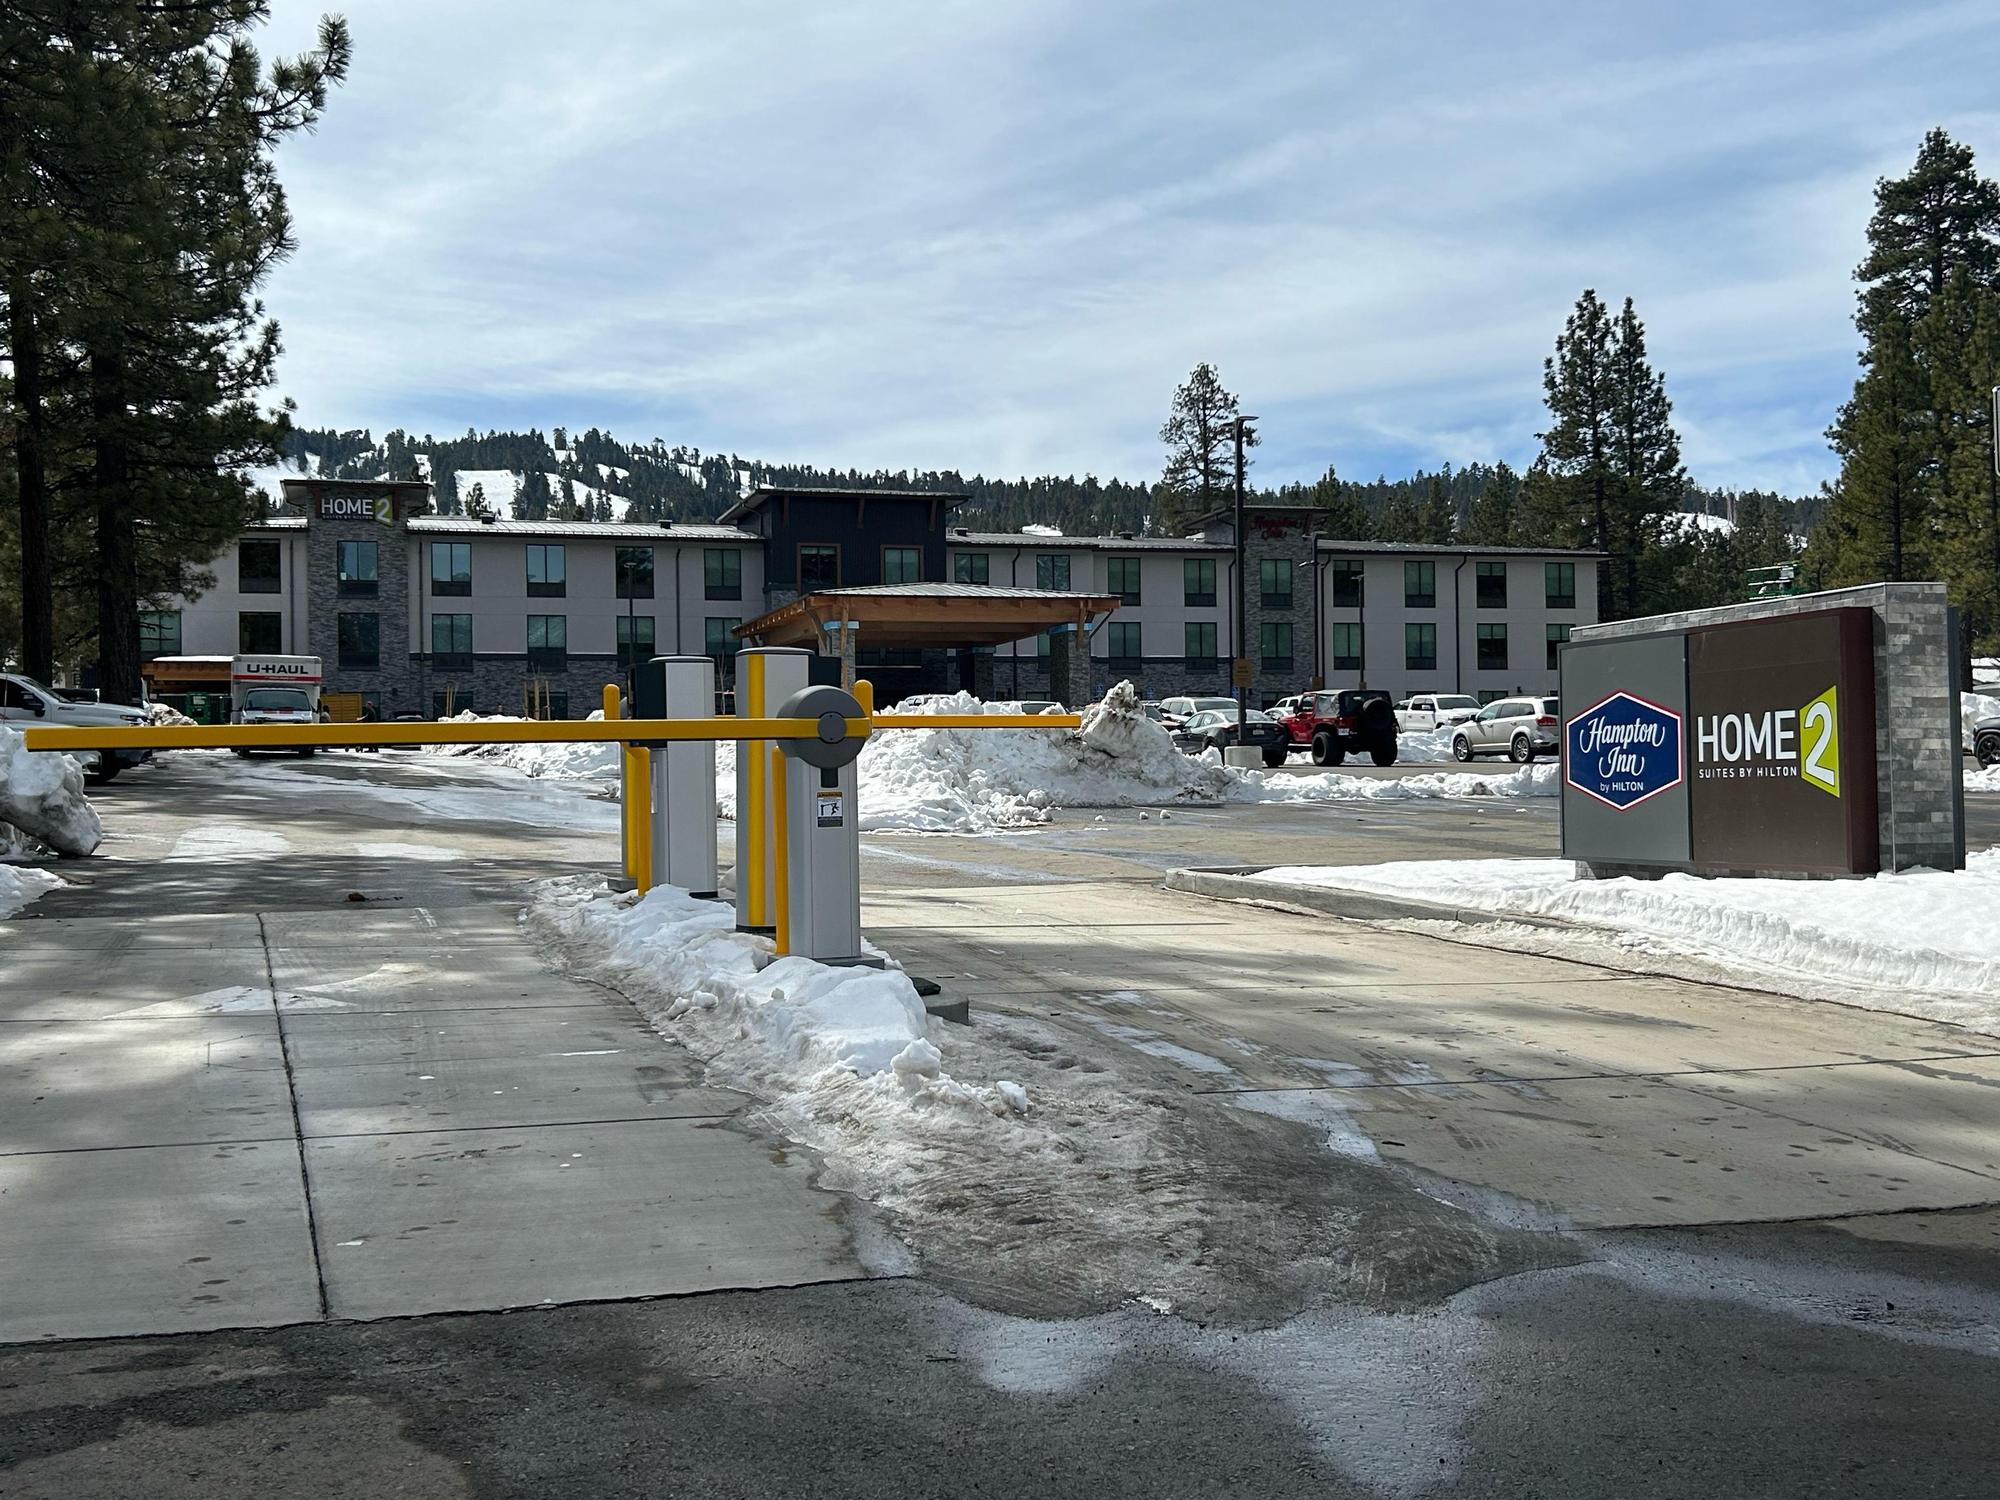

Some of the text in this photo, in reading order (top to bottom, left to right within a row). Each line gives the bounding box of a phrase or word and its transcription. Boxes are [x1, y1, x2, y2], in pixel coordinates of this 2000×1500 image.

[321, 498, 391, 522] HOME 2
[247, 664, 309, 674] U-HAUL
[1579, 715, 1665, 754] Hampton
[1697, 701, 1835, 787] HOME 2
[1599, 746, 1645, 779] Inn
[1699, 766, 1797, 779] SUITES BY HILTON
[1600, 781, 1644, 793] by HILTON
